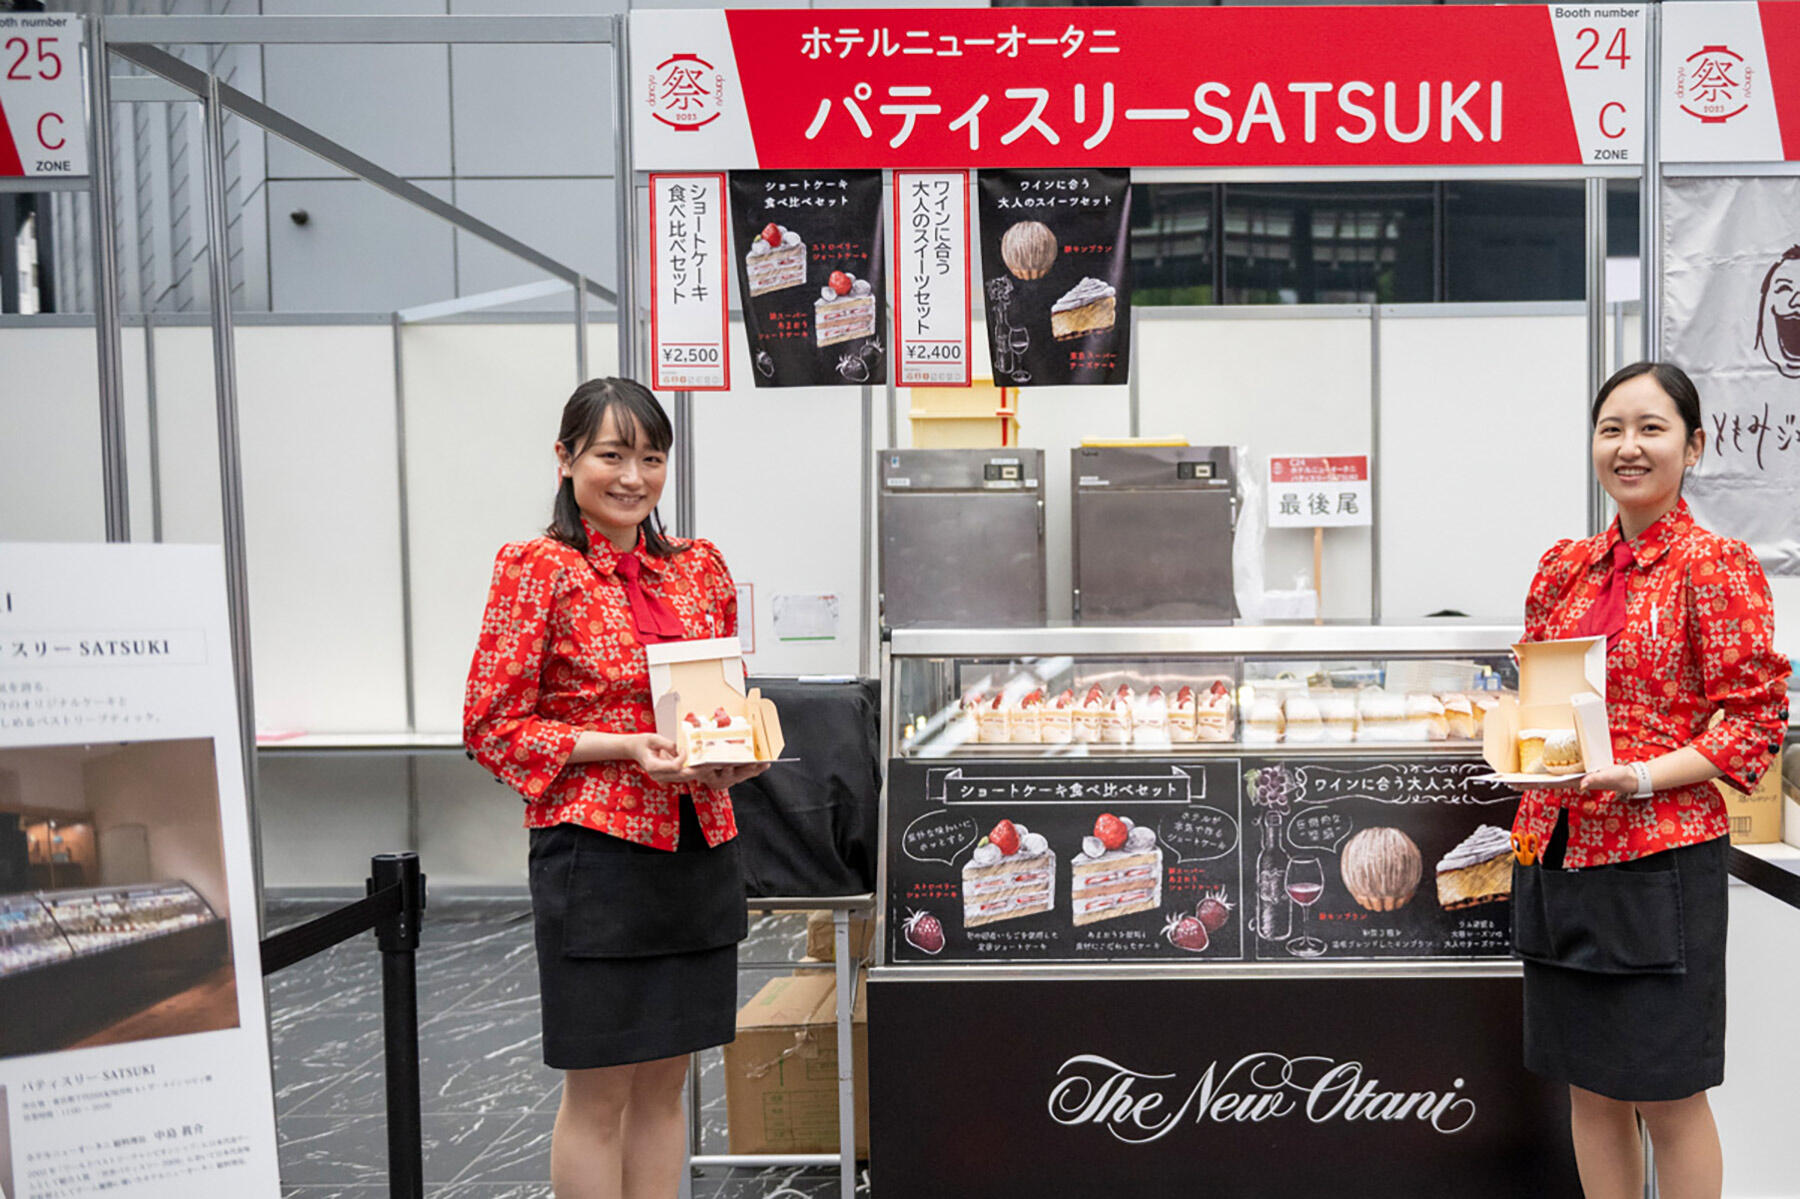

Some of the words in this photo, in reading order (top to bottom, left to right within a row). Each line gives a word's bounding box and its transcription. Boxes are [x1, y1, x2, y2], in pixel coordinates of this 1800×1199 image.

[20, 17, 67, 28] number
[1555, 7, 1591, 18] Booth
[1594, 8, 1640, 18] number
[5, 37, 62, 81] 25
[801, 26, 1120, 60] ホテルニューオータニ
[1575, 27, 1631, 70] 24
[661, 65, 711, 110] 祭
[1688, 57, 1739, 102] 祭
[36, 112, 66, 150] C
[805, 81, 1503, 151] パティスリーSATSUKI
[1599, 101, 1627, 139] C
[36, 161, 71, 171] ZONE
[1594, 149, 1629, 160] ZONE
[764, 195, 848, 209] 食べ比べセット
[765, 179, 848, 192] ショートケーキ
[998, 195, 1111, 209] 大人のスイーツセット
[1020, 178, 1090, 192] ワインに合う
[668, 184, 687, 304] 食べ比べセット
[690, 184, 709, 302] ショートケーキ
[934, 180, 951, 275] ワインに合う
[912, 180, 930, 335] 大人のスイーツセット
[663, 348, 719, 363] ¥2,500
[906, 345, 961, 360] ¥2,400
[1711, 402, 1800, 471] ともみジ
[1279, 492, 1360, 516] 最後尾
[960, 782, 1178, 798] ショートケーキ食べ比べセット
[1048, 1053, 1176, 1131] The
[1282, 1056, 1476, 1134] Otani
